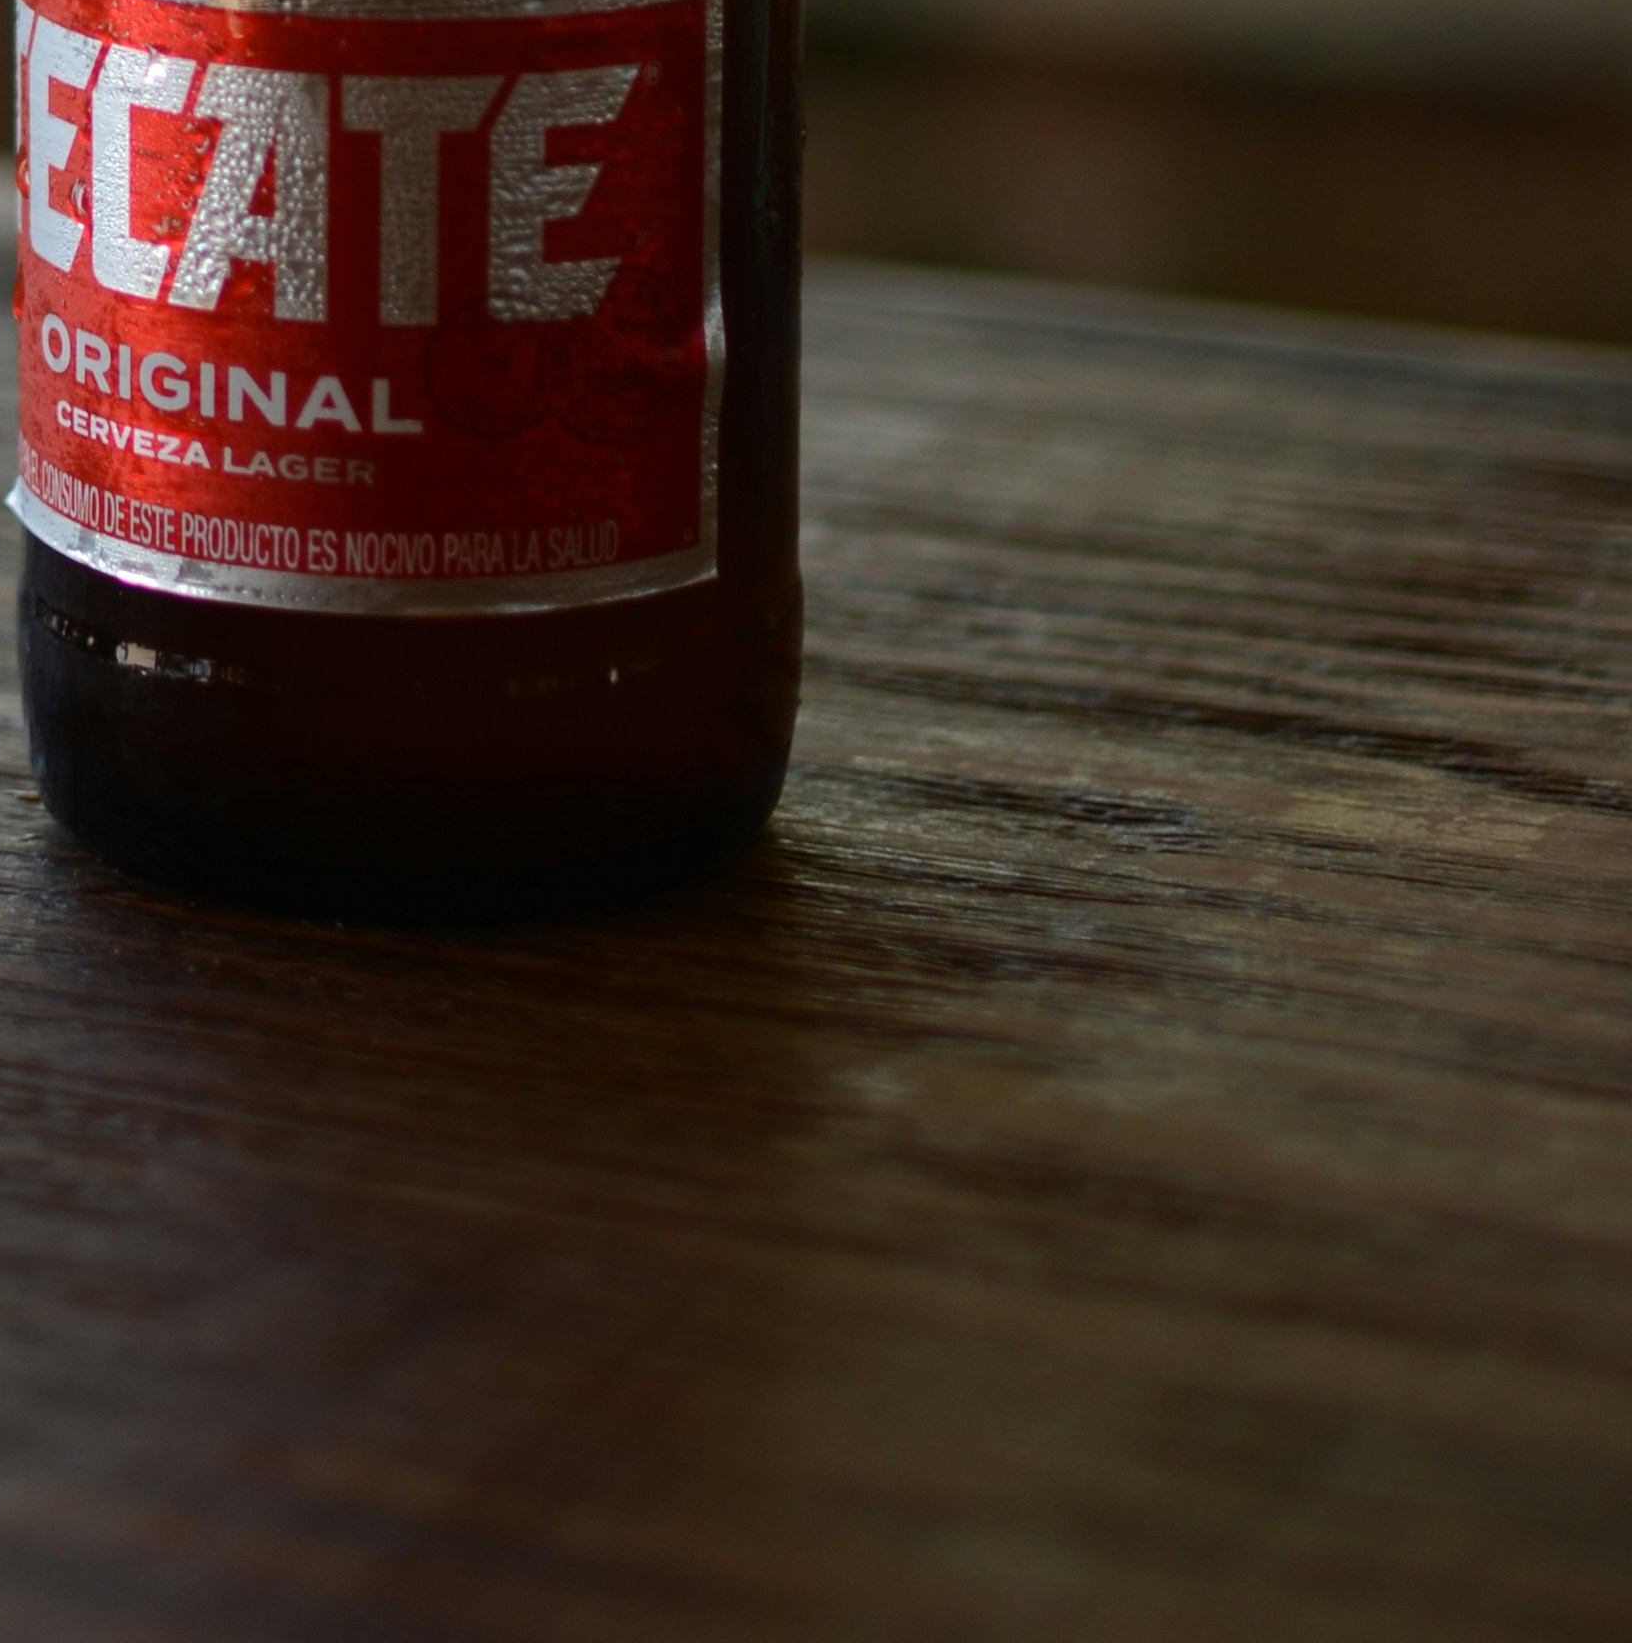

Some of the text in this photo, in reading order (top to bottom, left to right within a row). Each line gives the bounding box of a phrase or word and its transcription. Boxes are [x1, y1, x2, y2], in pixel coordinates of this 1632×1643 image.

[41, 313, 425, 436] ORIGINAL
[56, 399, 212, 471] CERVEZA
[223, 446, 377, 487] LAGER
[41, 459, 100, 529] CONSUMO
[104, 490, 125, 538] DE
[130, 498, 176, 551] ESTE
[181, 511, 301, 570] PRODUCTO
[307, 528, 339, 573] ES
[344, 531, 437, 576] NOCIVO
[442, 530, 507, 576] PARA
[511, 529, 543, 572] LA
[547, 518, 619, 570] SALUD
